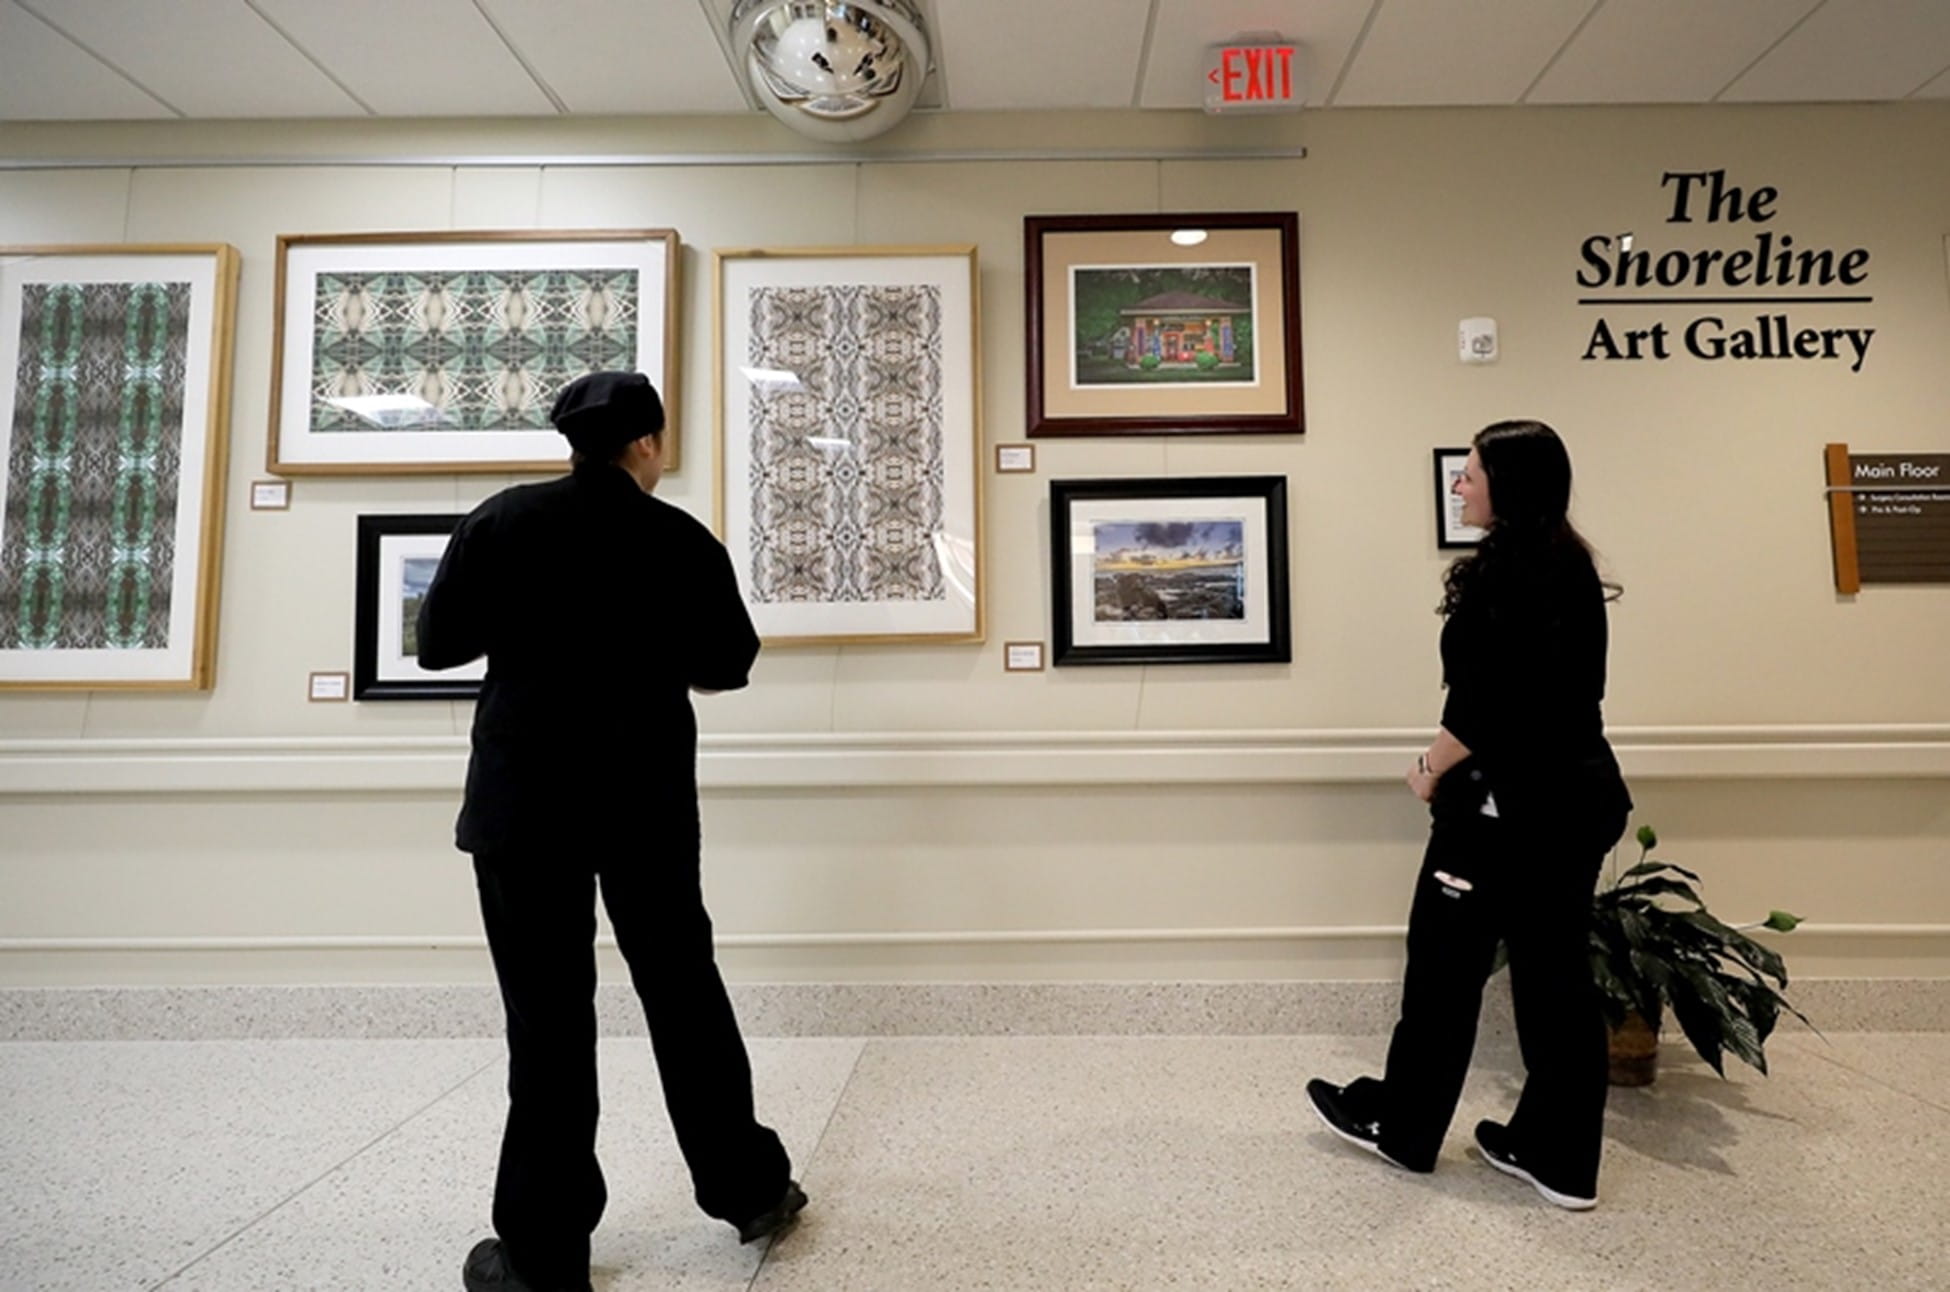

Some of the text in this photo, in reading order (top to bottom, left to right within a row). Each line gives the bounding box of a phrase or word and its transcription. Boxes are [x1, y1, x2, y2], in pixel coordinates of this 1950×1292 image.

[1222, 47, 1296, 101] EXIT
[1661, 169, 1778, 223] The
[1576, 231, 1870, 288] Shoreline
[1581, 315, 1876, 373] Art Gallery
[1854, 462, 1939, 478] Main Floor
